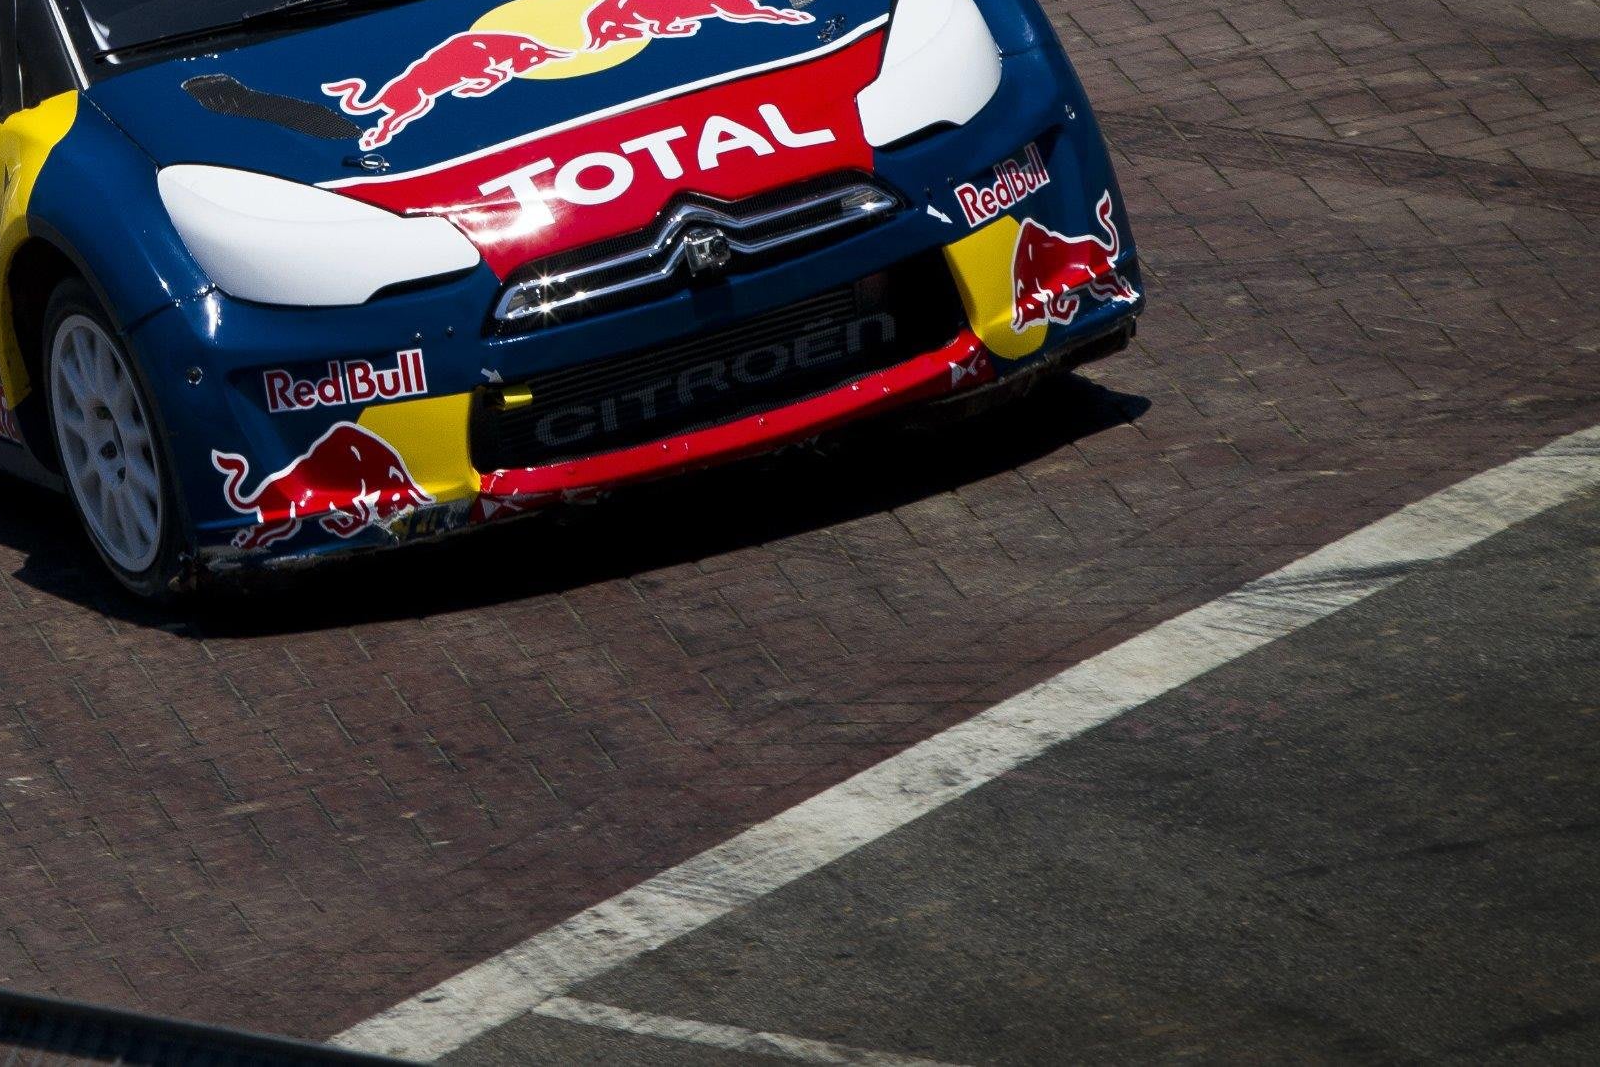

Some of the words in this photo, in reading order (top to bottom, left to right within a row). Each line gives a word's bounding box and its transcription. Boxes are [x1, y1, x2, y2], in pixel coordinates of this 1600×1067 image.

[477, 103, 836, 225] TOTAL
[954, 164, 1016, 228] Red
[1002, 141, 1050, 202] Bull
[263, 360, 345, 413] Red
[344, 348, 428, 404] Bull
[534, 311, 896, 446] CITROËN
